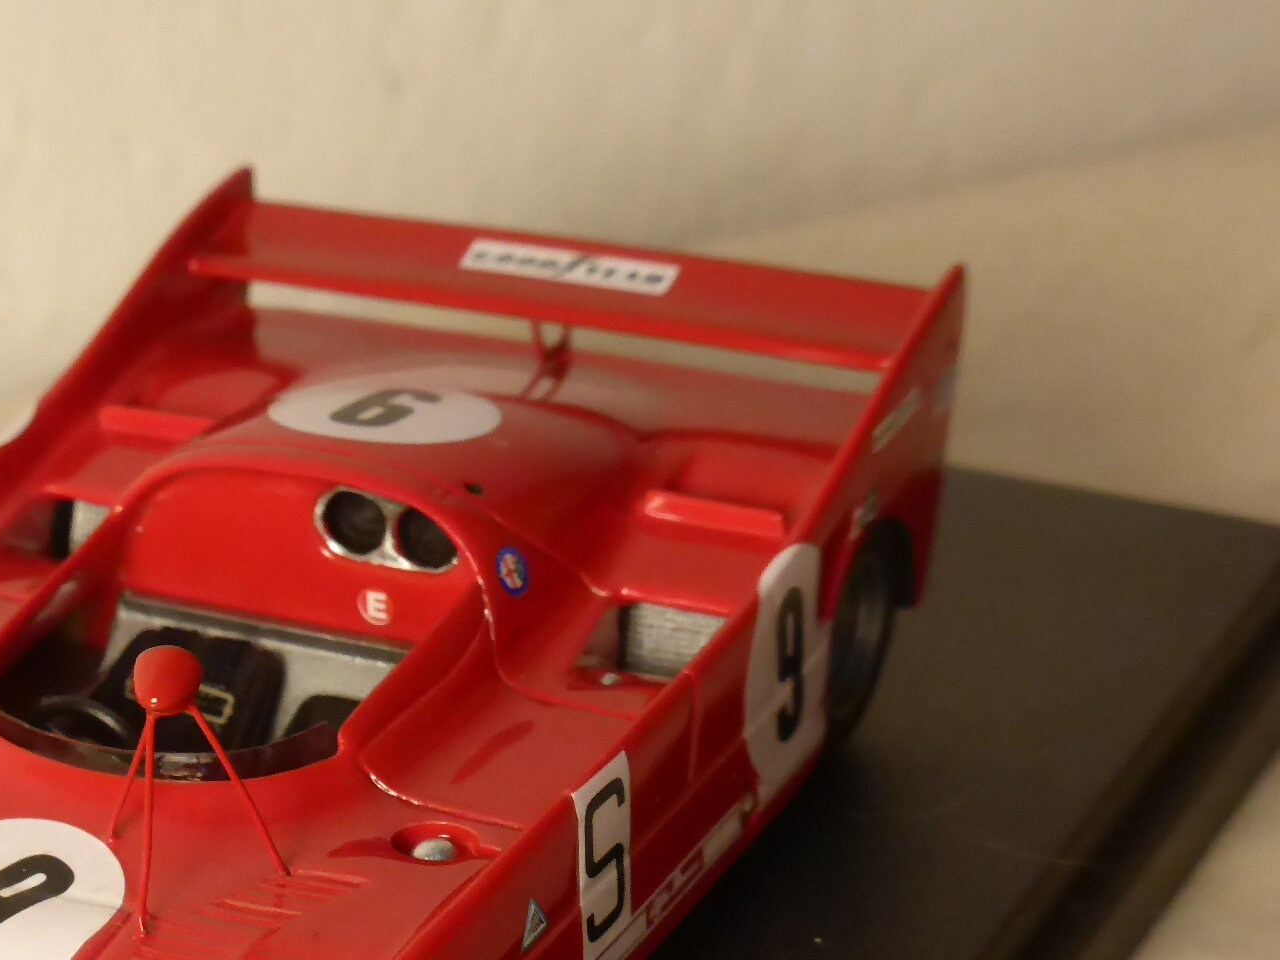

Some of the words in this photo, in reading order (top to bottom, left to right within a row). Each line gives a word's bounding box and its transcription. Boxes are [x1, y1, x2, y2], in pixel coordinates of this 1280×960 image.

[365, 590, 389, 620] E
[776, 585, 805, 743] 9
[584, 776, 626, 943] S
